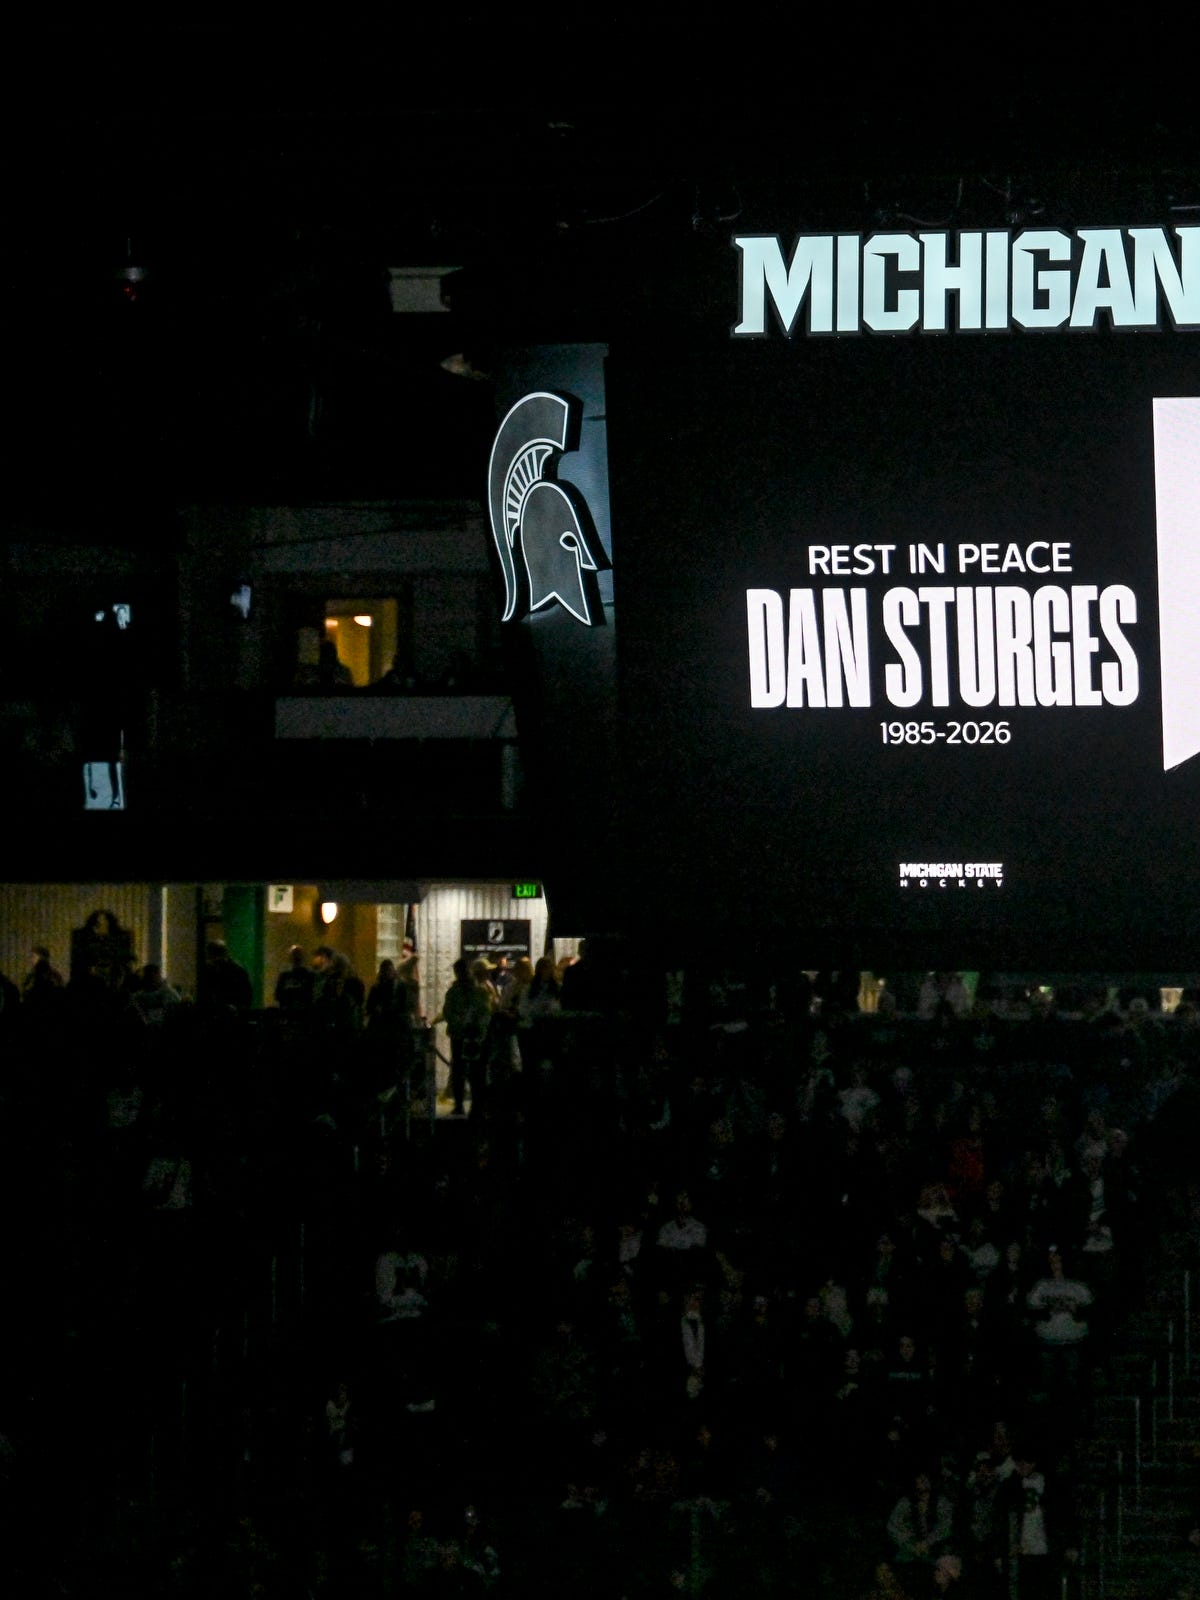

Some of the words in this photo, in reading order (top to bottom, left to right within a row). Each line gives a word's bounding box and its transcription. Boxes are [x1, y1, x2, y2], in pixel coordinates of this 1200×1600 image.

[807, 542, 897, 575] REST
[909, 542, 946, 575] IN
[957, 540, 1074, 574] PEACE
[745, 586, 872, 709] DAN
[882, 583, 1141, 708] STURGES
[879, 721, 1012, 745] 1985-2026
[899, 862, 963, 878] MICHIGAN
[964, 862, 1004, 878] STATE
[515, 883, 538, 898] EXIT
[899, 878, 1003, 888] HOCKEY
